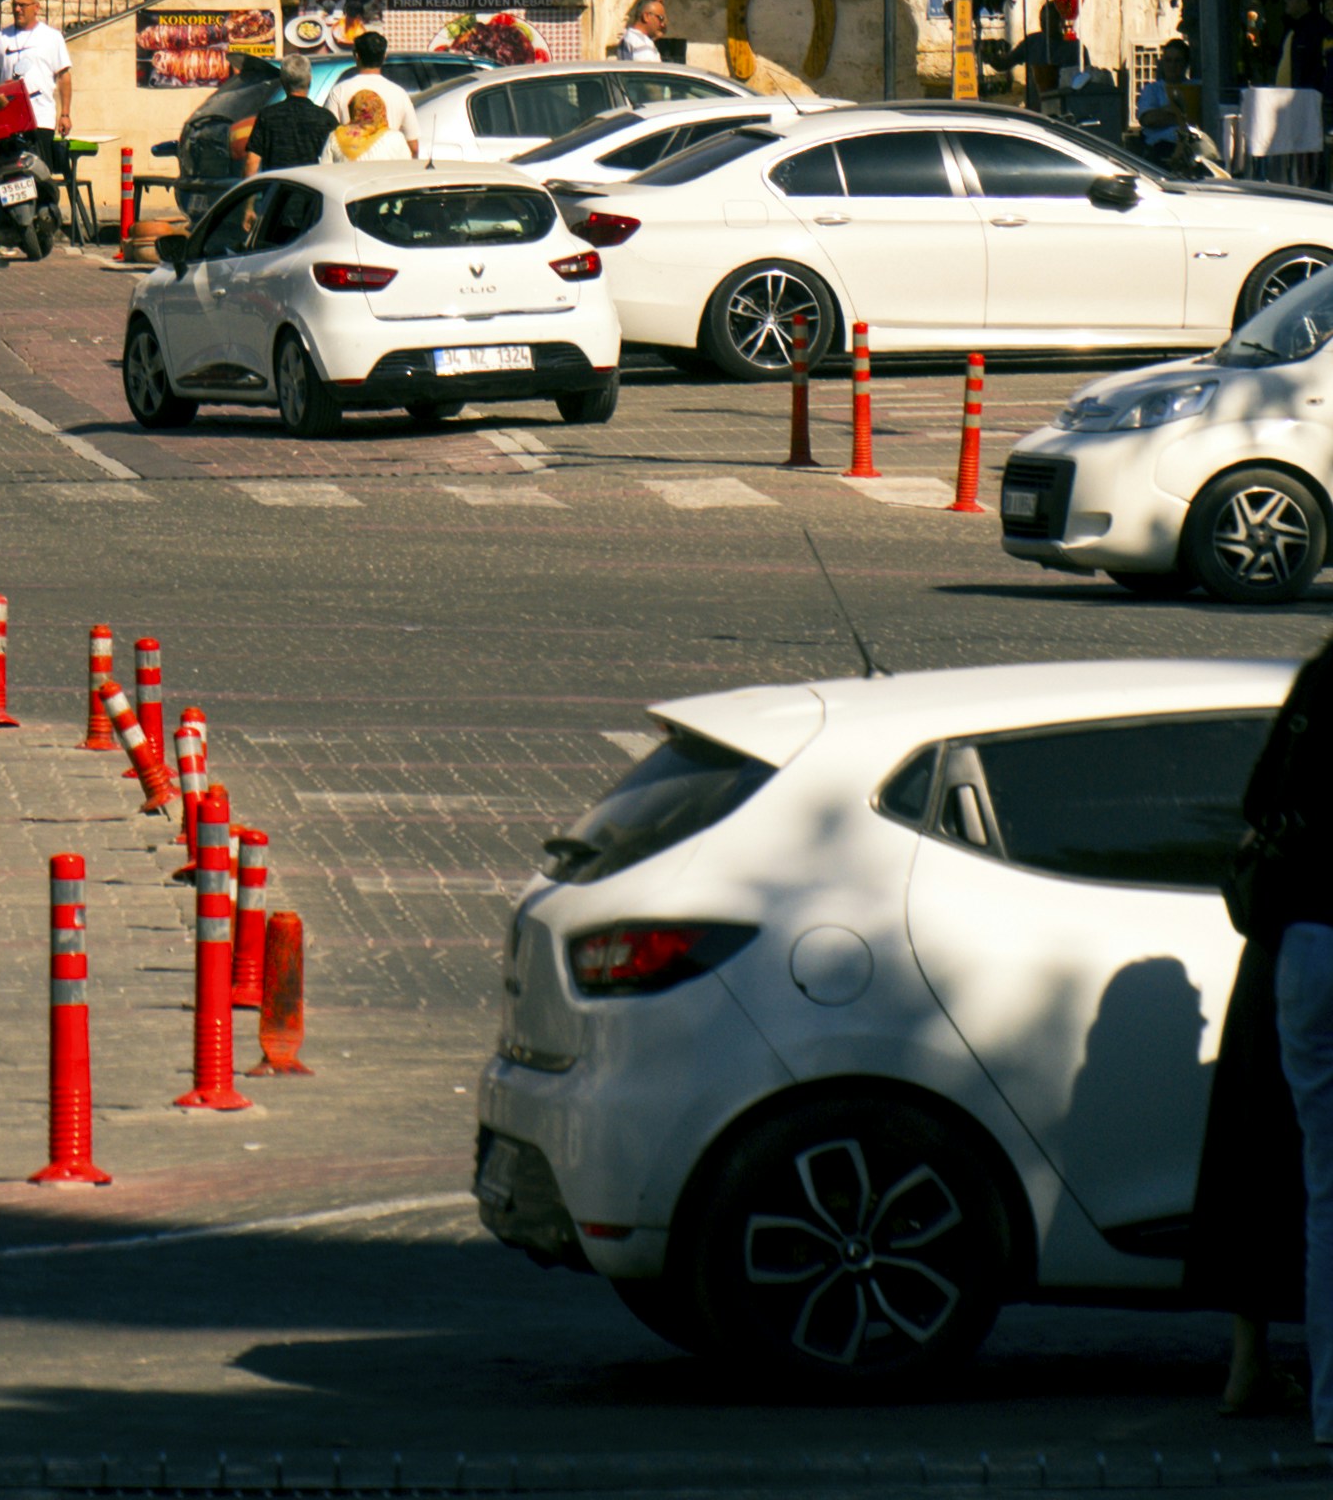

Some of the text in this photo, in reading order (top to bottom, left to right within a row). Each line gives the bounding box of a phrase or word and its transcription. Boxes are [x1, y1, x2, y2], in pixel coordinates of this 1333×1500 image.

[460, 285, 497, 294] CLIO
[444, 350, 462, 366] 34
[497, 348, 530, 364] 1324
